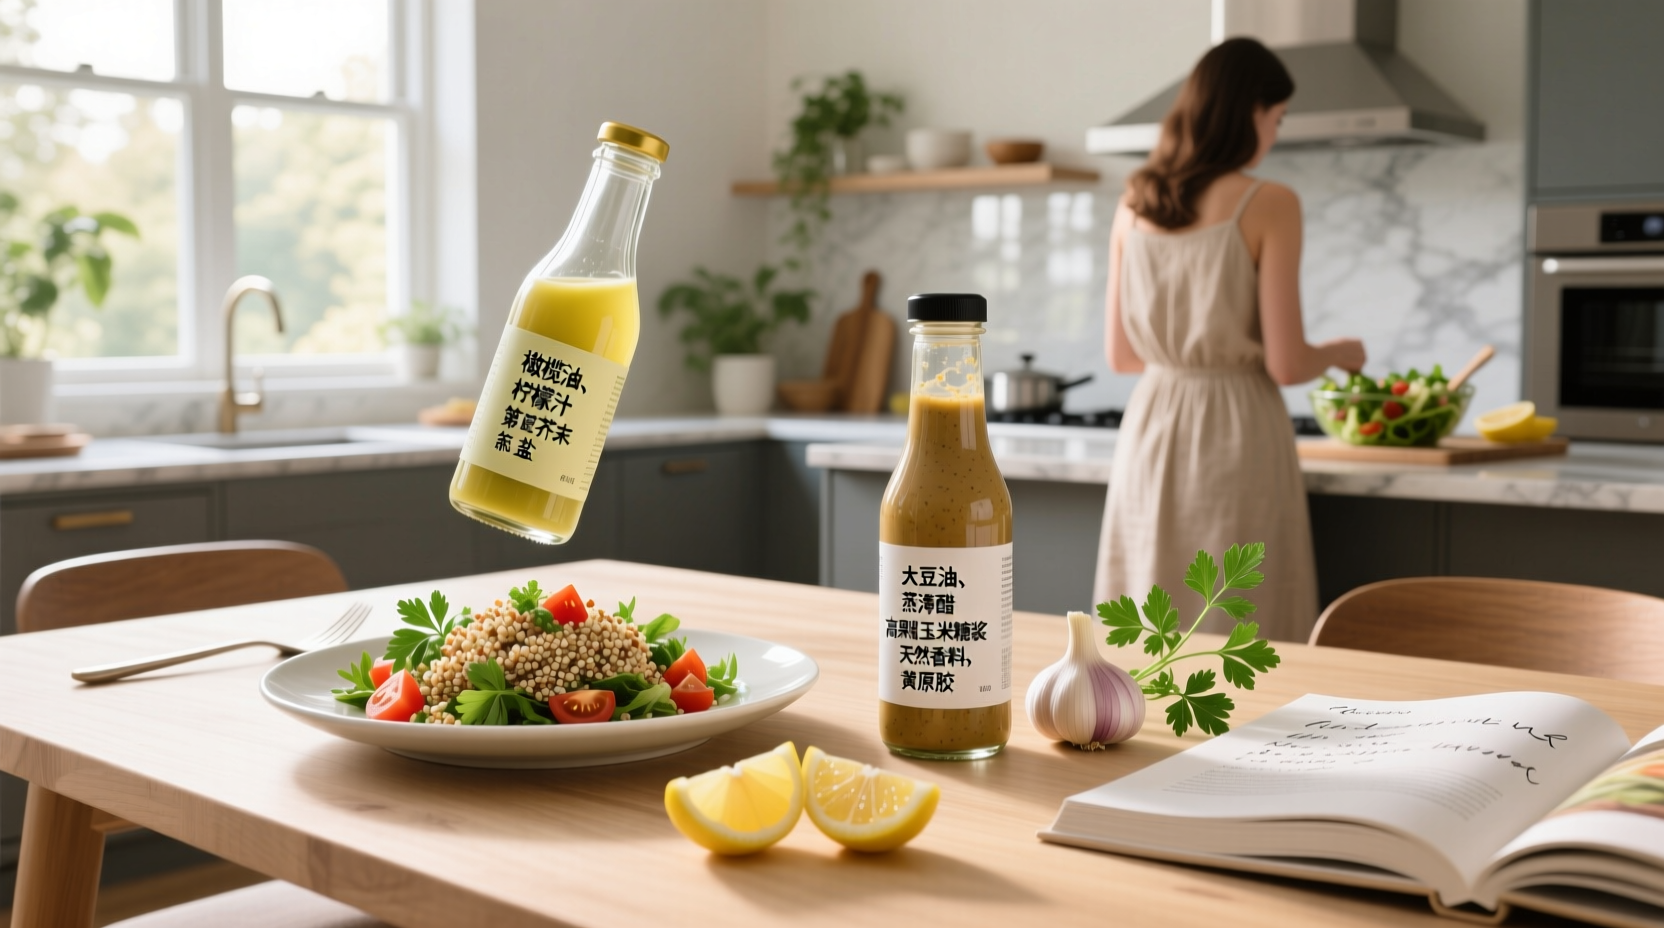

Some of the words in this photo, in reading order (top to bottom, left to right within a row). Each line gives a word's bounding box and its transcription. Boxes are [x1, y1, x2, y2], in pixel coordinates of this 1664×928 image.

[902, 565, 965, 588] 大豆油、
[901, 670, 955, 692] 黄原胶
